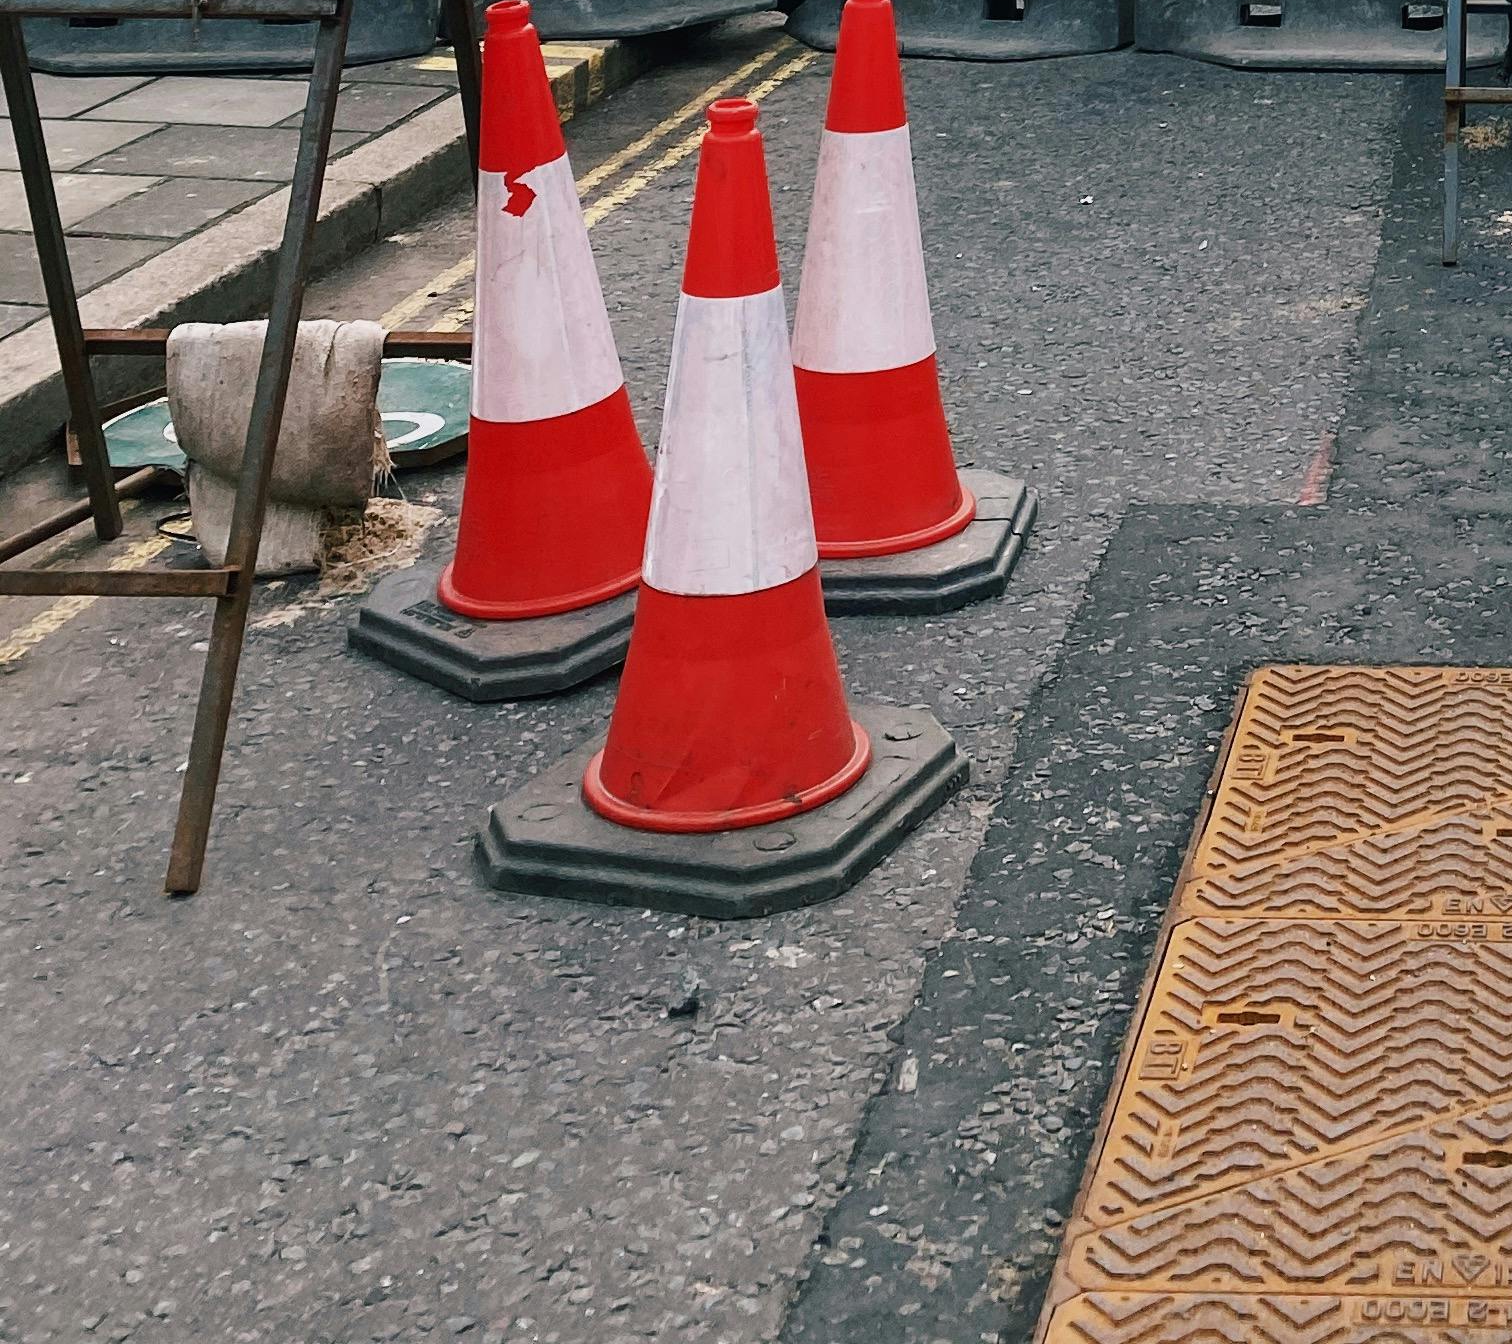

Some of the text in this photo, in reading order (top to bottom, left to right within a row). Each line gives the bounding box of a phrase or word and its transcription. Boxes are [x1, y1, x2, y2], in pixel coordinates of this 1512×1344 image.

[1445, 898, 1484, 914] EN
[1417, 923, 1488, 939] E600
[1144, 1041, 1183, 1075] BT
[1394, 1260, 1445, 1288] EN
